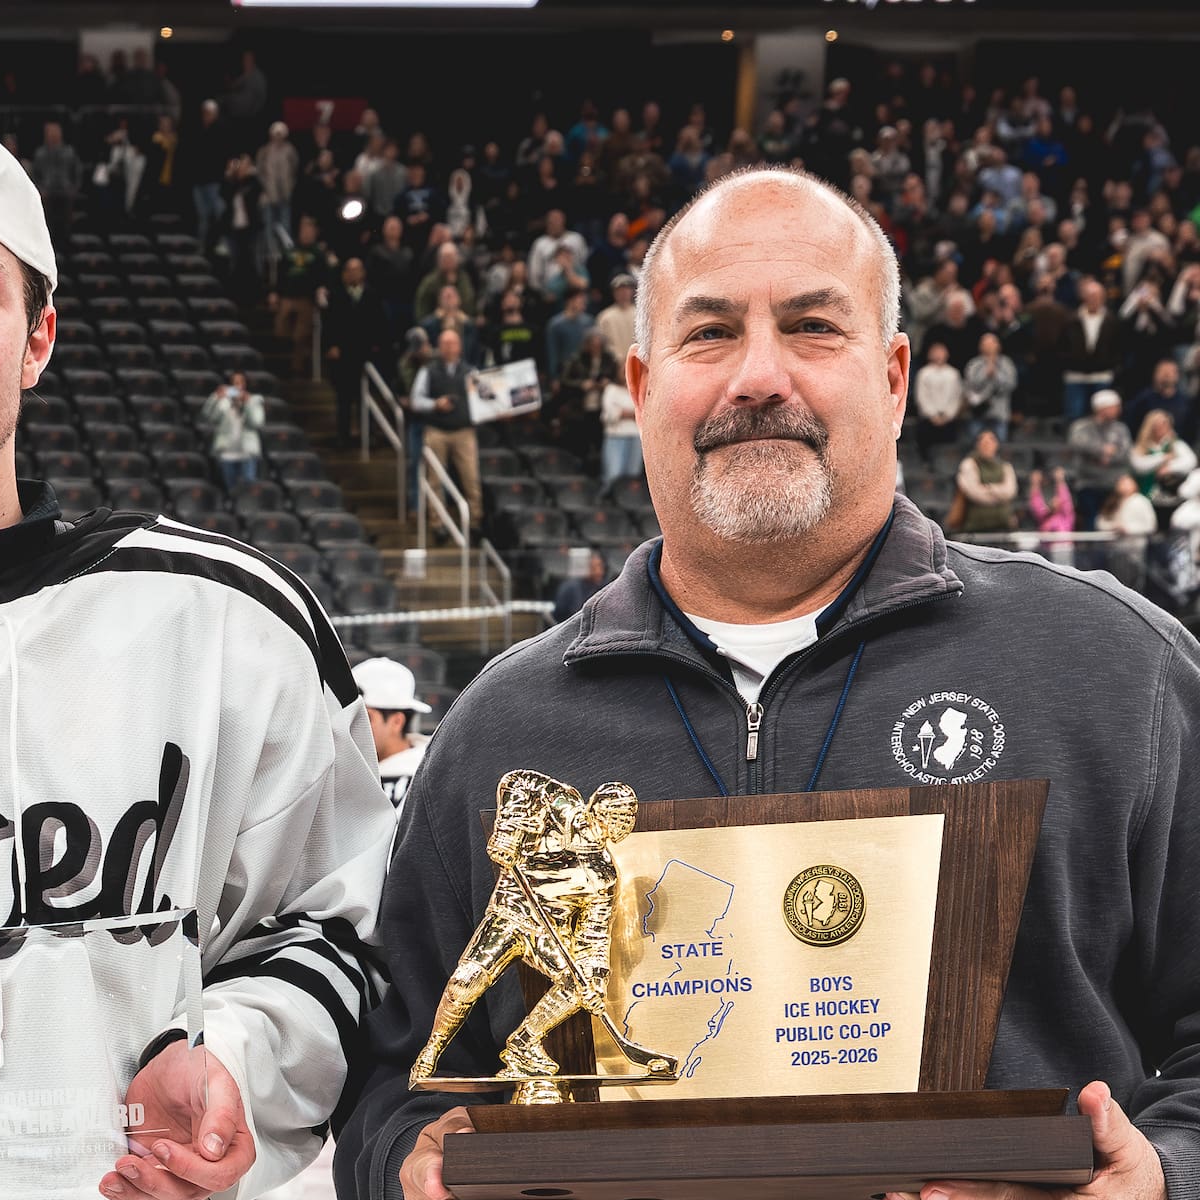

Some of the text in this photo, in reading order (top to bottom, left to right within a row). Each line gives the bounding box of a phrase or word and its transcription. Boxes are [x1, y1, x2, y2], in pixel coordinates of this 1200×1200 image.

[903, 691, 999, 720] NEW JERSEY STATE
[970, 728, 984, 760] 1918
[838, 892, 848, 912] 1918
[661, 941, 723, 959] STATE
[631, 977, 753, 998] CHAMPIONS
[809, 976, 853, 993] BOYS
[784, 998, 880, 1018] ICE HOCKEY
[775, 1022, 891, 1043] PUBLIC CO-OP
[791, 1047, 878, 1066] 2025-2026
